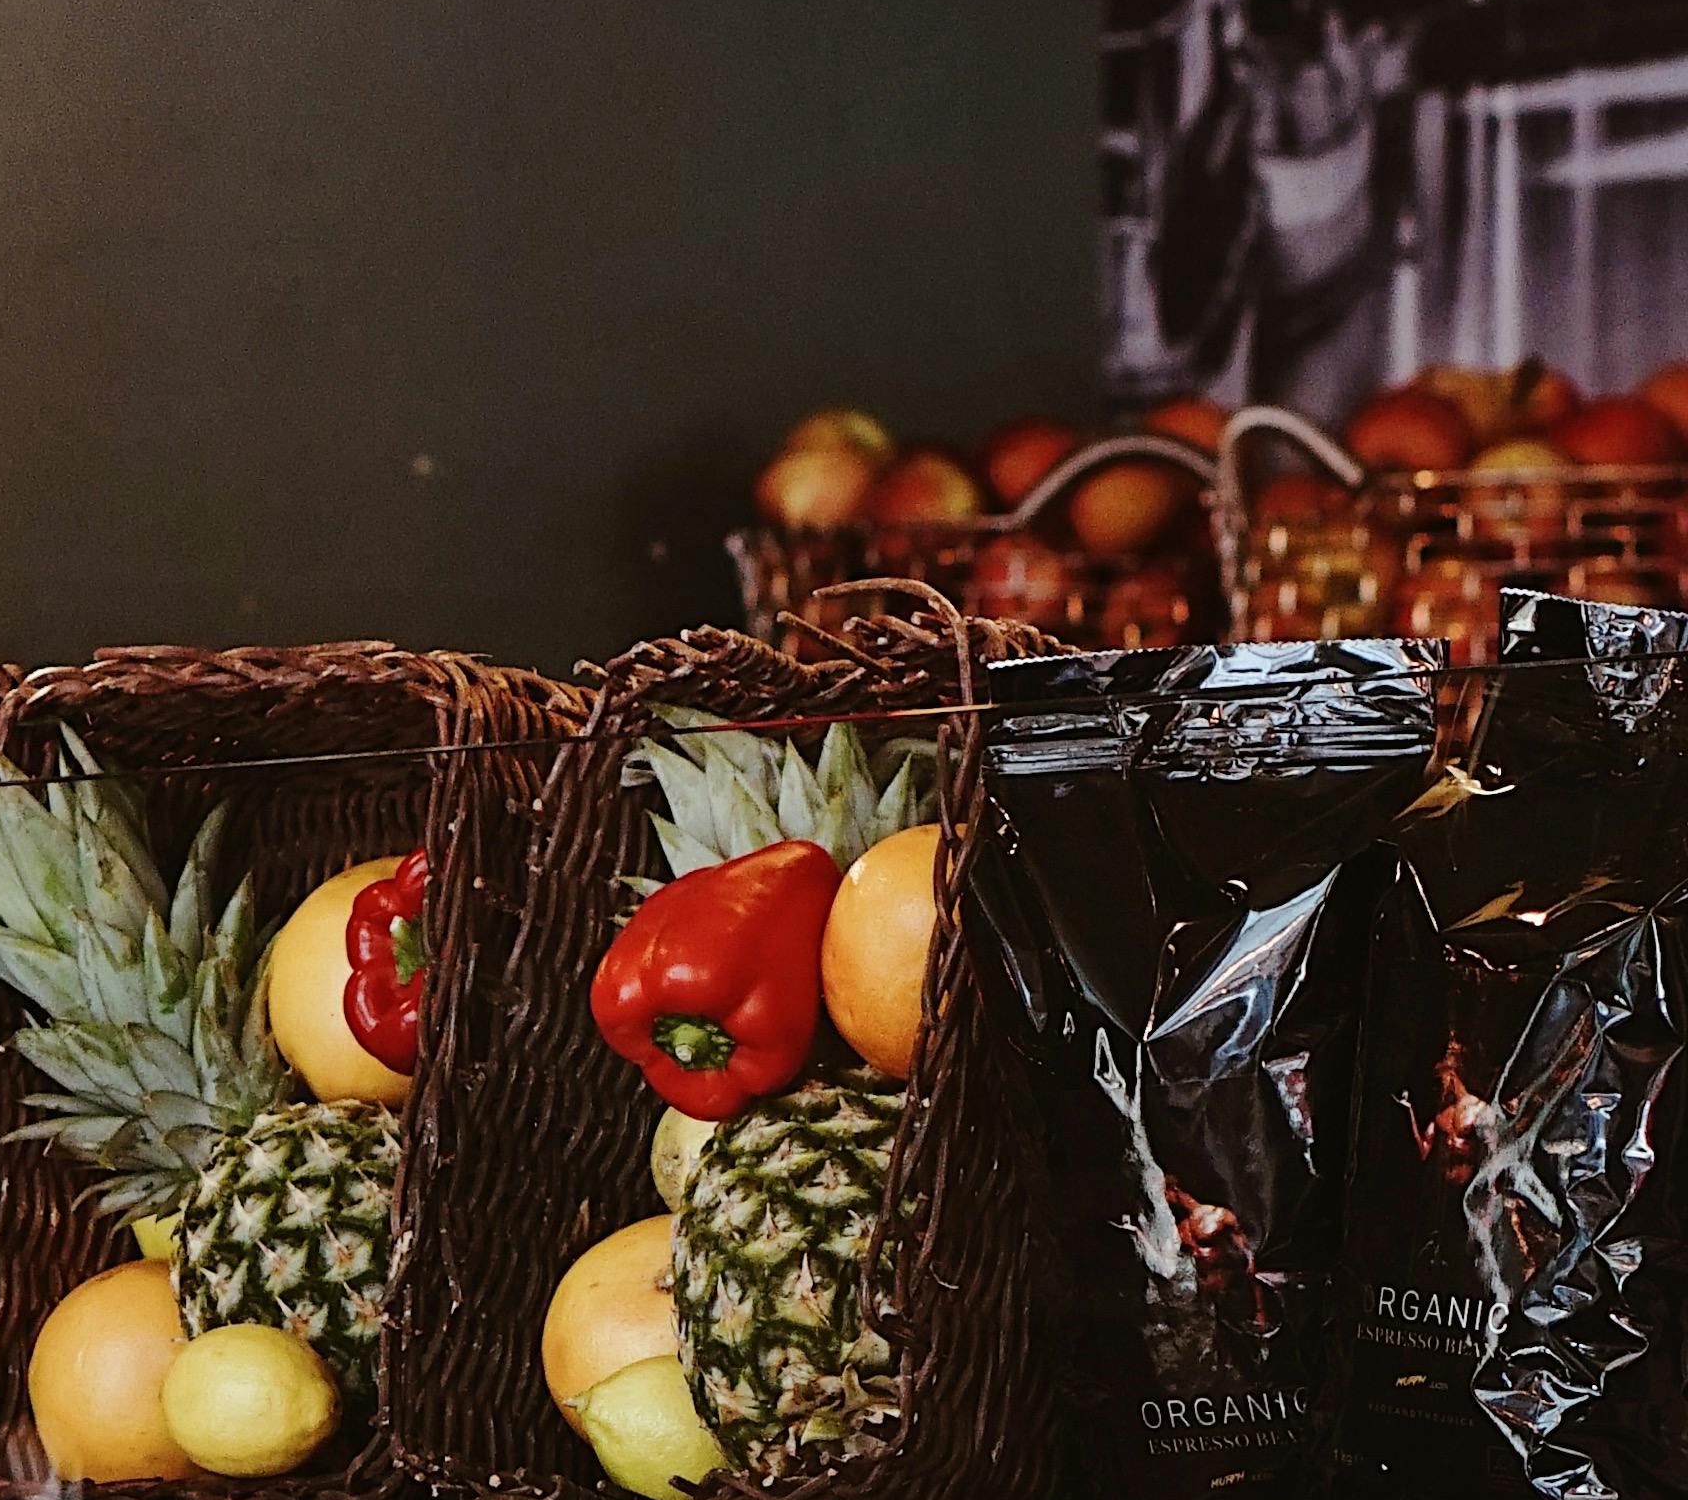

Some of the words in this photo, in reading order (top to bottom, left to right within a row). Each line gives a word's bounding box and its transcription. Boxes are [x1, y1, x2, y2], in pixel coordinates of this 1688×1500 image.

[1355, 1323, 1440, 1349] ESPRESSO
[1141, 1387, 1308, 1429] ORGANIC
[1147, 1433, 1250, 1455] ESPRESSO
